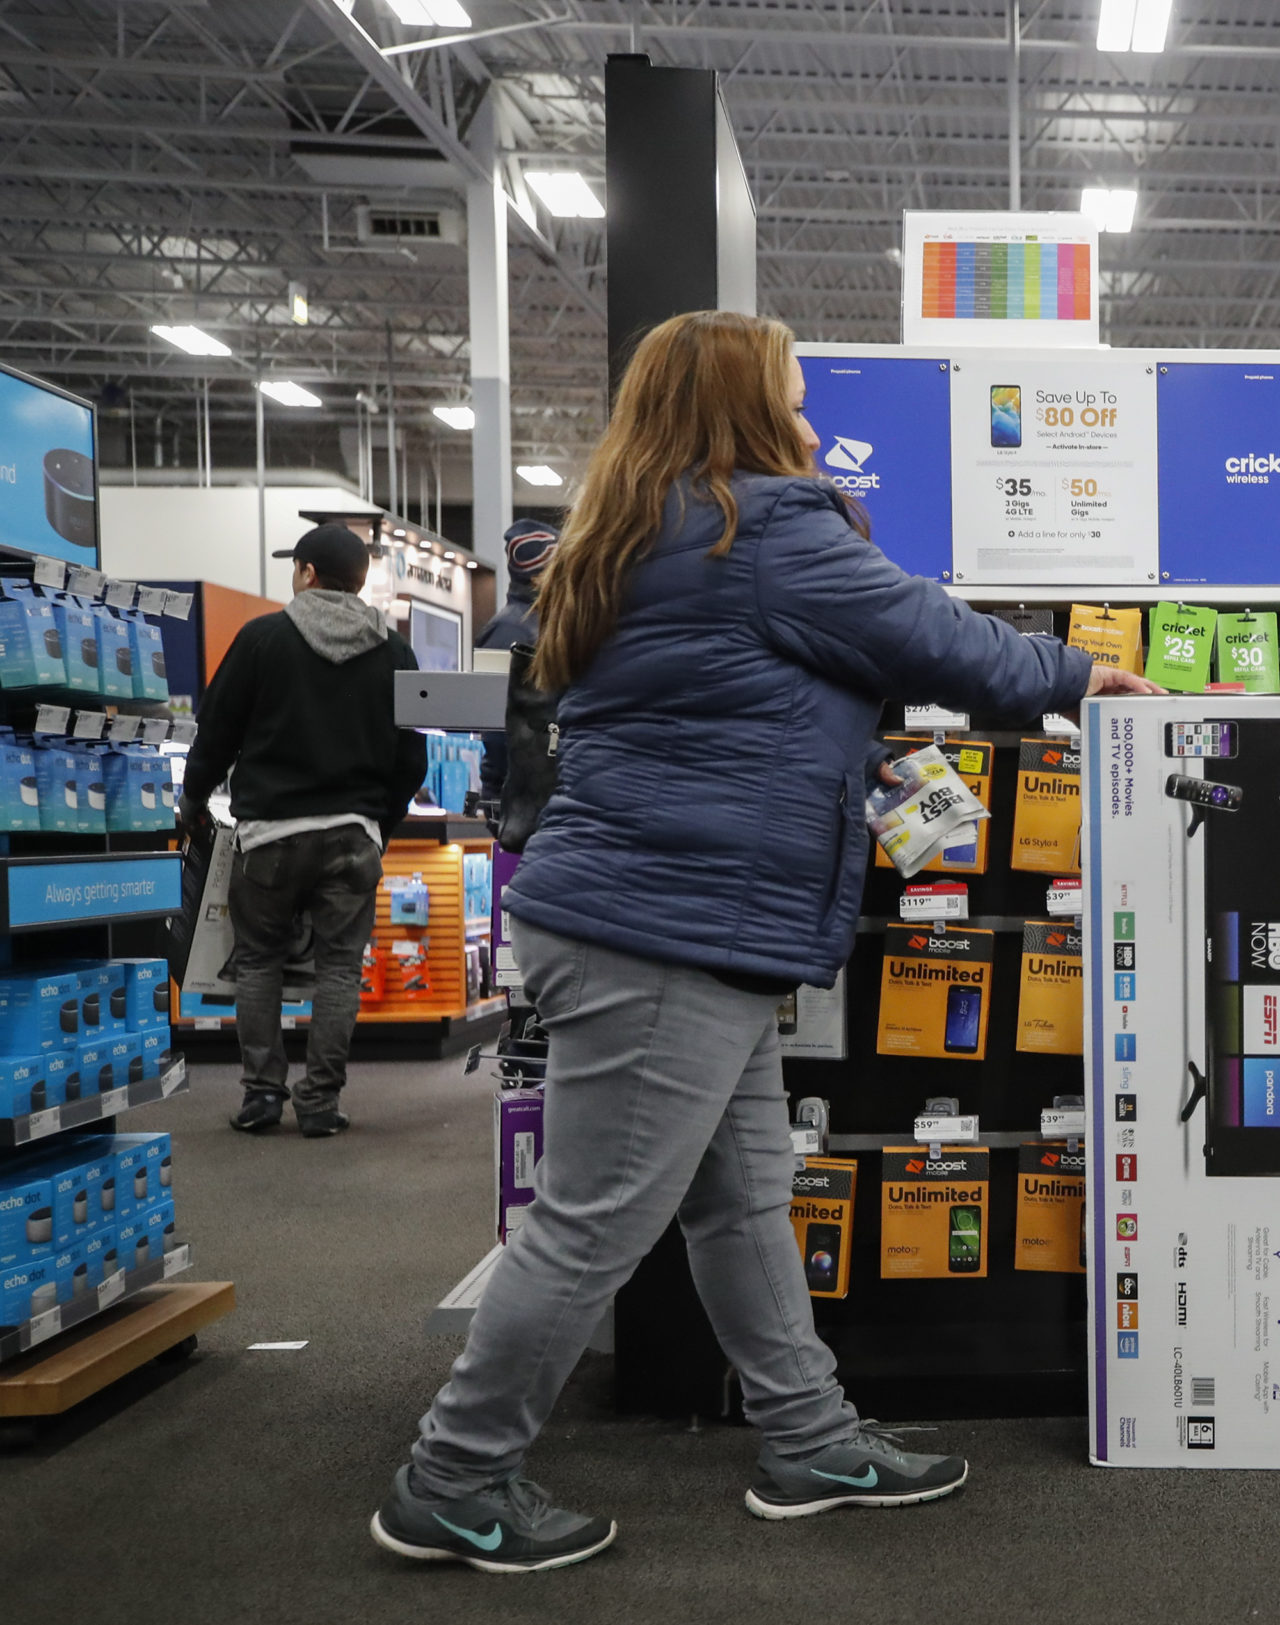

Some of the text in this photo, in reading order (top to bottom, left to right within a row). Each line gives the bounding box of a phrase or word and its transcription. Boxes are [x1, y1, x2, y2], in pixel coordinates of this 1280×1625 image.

[1036, 390, 1117, 407] Save Up To
[1036, 407, 1117, 428] $80 Off
[1226, 474, 1269, 485] wireless
[1070, 500, 1108, 508] Unlimited
[1070, 509, 1089, 517] Gigs
[1162, 622, 1206, 637] cricket
[1225, 631, 1269, 645] cricket
[1164, 636, 1195, 658] $25
[1231, 647, 1262, 667] $30
[1110, 718, 1120, 820] and TV episodes.
[1124, 718, 1133, 817] 500,000+ Movies
[919, 786, 954, 814] BUY
[921, 794, 965, 825] BEST
[45, 879, 155, 905] Always getting smarter
[928, 936, 970, 952] boost
[1251, 923, 1267, 969] NOW
[889, 962, 984, 984] Unlimited
[1264, 995, 1277, 1045] ESPN
[1266, 1070, 1276, 1116] pandora
[926, 1159, 967, 1173] boost
[888, 1186, 982, 1204] Unlimited
[4, 1269, 46, 1289] echo dot
[1178, 1282, 1187, 1326] HDMI
